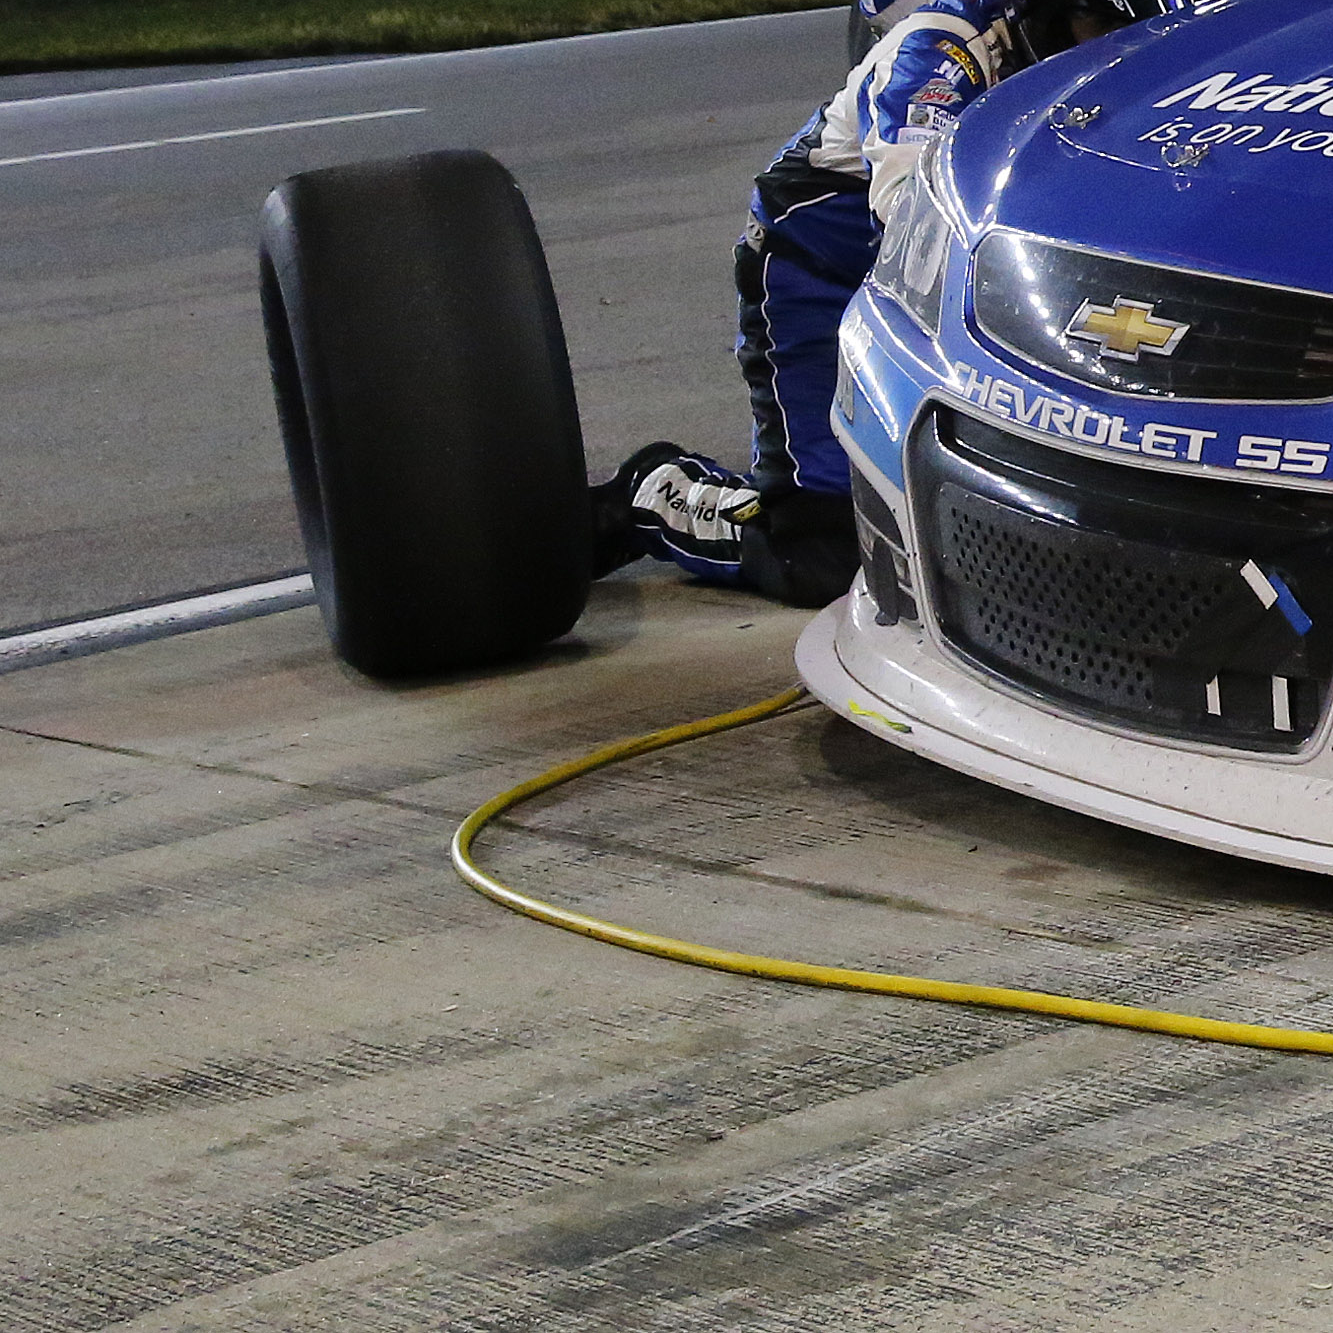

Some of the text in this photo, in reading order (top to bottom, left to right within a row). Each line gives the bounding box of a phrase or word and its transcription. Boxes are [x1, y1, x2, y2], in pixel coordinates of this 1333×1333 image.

[1137, 116, 1194, 143] is
[1189, 122, 1265, 146] on
[950, 360, 1218, 462] CHEVROLET
[1234, 434, 1331, 475] SS
